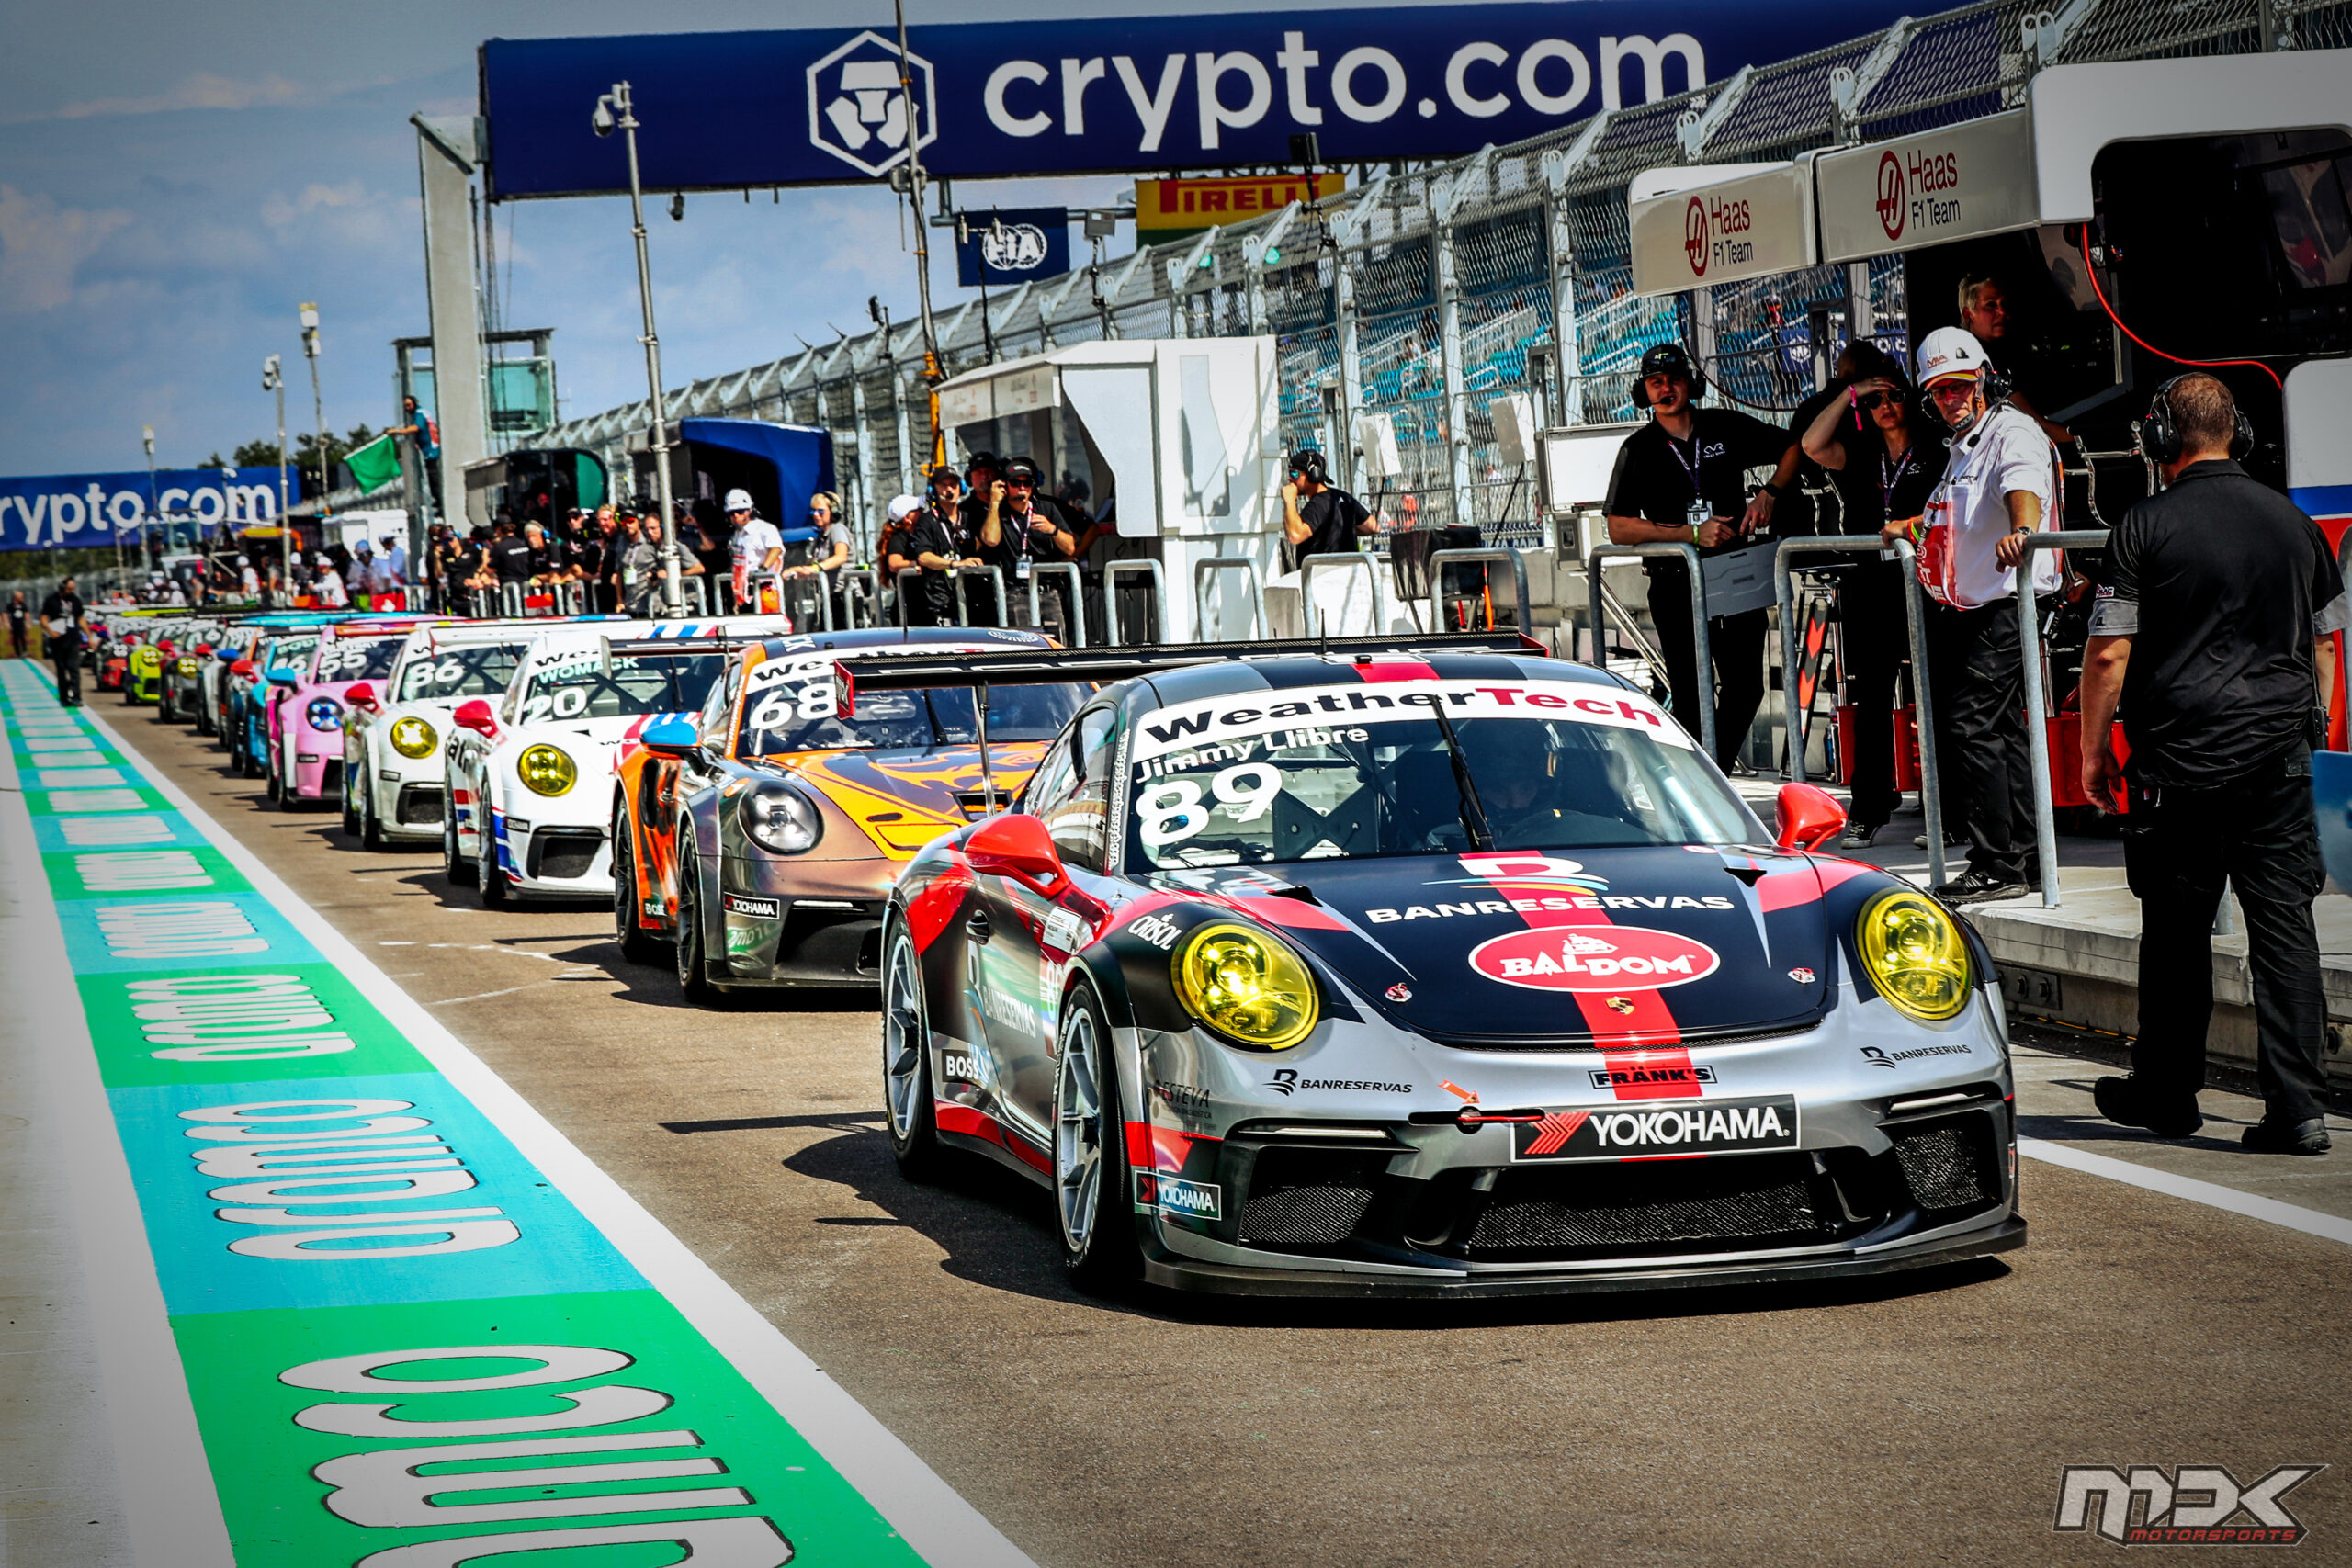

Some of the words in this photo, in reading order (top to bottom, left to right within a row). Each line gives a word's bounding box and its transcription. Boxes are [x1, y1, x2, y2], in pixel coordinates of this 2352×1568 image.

[984, 31, 1706, 152] crypto.com
[1907, 150, 1959, 196] Haas
[1710, 196, 1751, 236] Haas
[1911, 200, 1925, 230] F1
[1926, 197, 1962, 227] Team
[1713, 243, 1724, 267] F1
[1725, 240, 1754, 265] Team
[318, 647, 368, 675] 55
[407, 659, 464, 690] 86
[522, 687, 587, 724] 20
[749, 682, 838, 730] 68
[1145, 687, 1662, 744] WeatherTech
[1136, 739, 1256, 784] Jimmy
[1261, 728, 1370, 752] Llibre
[1135, 761, 1283, 846] 89
[1364, 895, 1736, 924] BANRESERVAS
[1499, 951, 1694, 978] BALDOM
[981, 985, 1037, 1039] BANRESERVAS
[1891, 1044, 1973, 1062] BANRESERVAS
[1300, 1078, 1413, 1094] BANRESERVAS
[1593, 1066, 1712, 1086] FRÄNK'S
[1588, 1106, 1787, 1146] YOKOHAMA
[177, 1099, 522, 1260] aramco
[1158, 1182, 1216, 1213] YOKOHAMA
